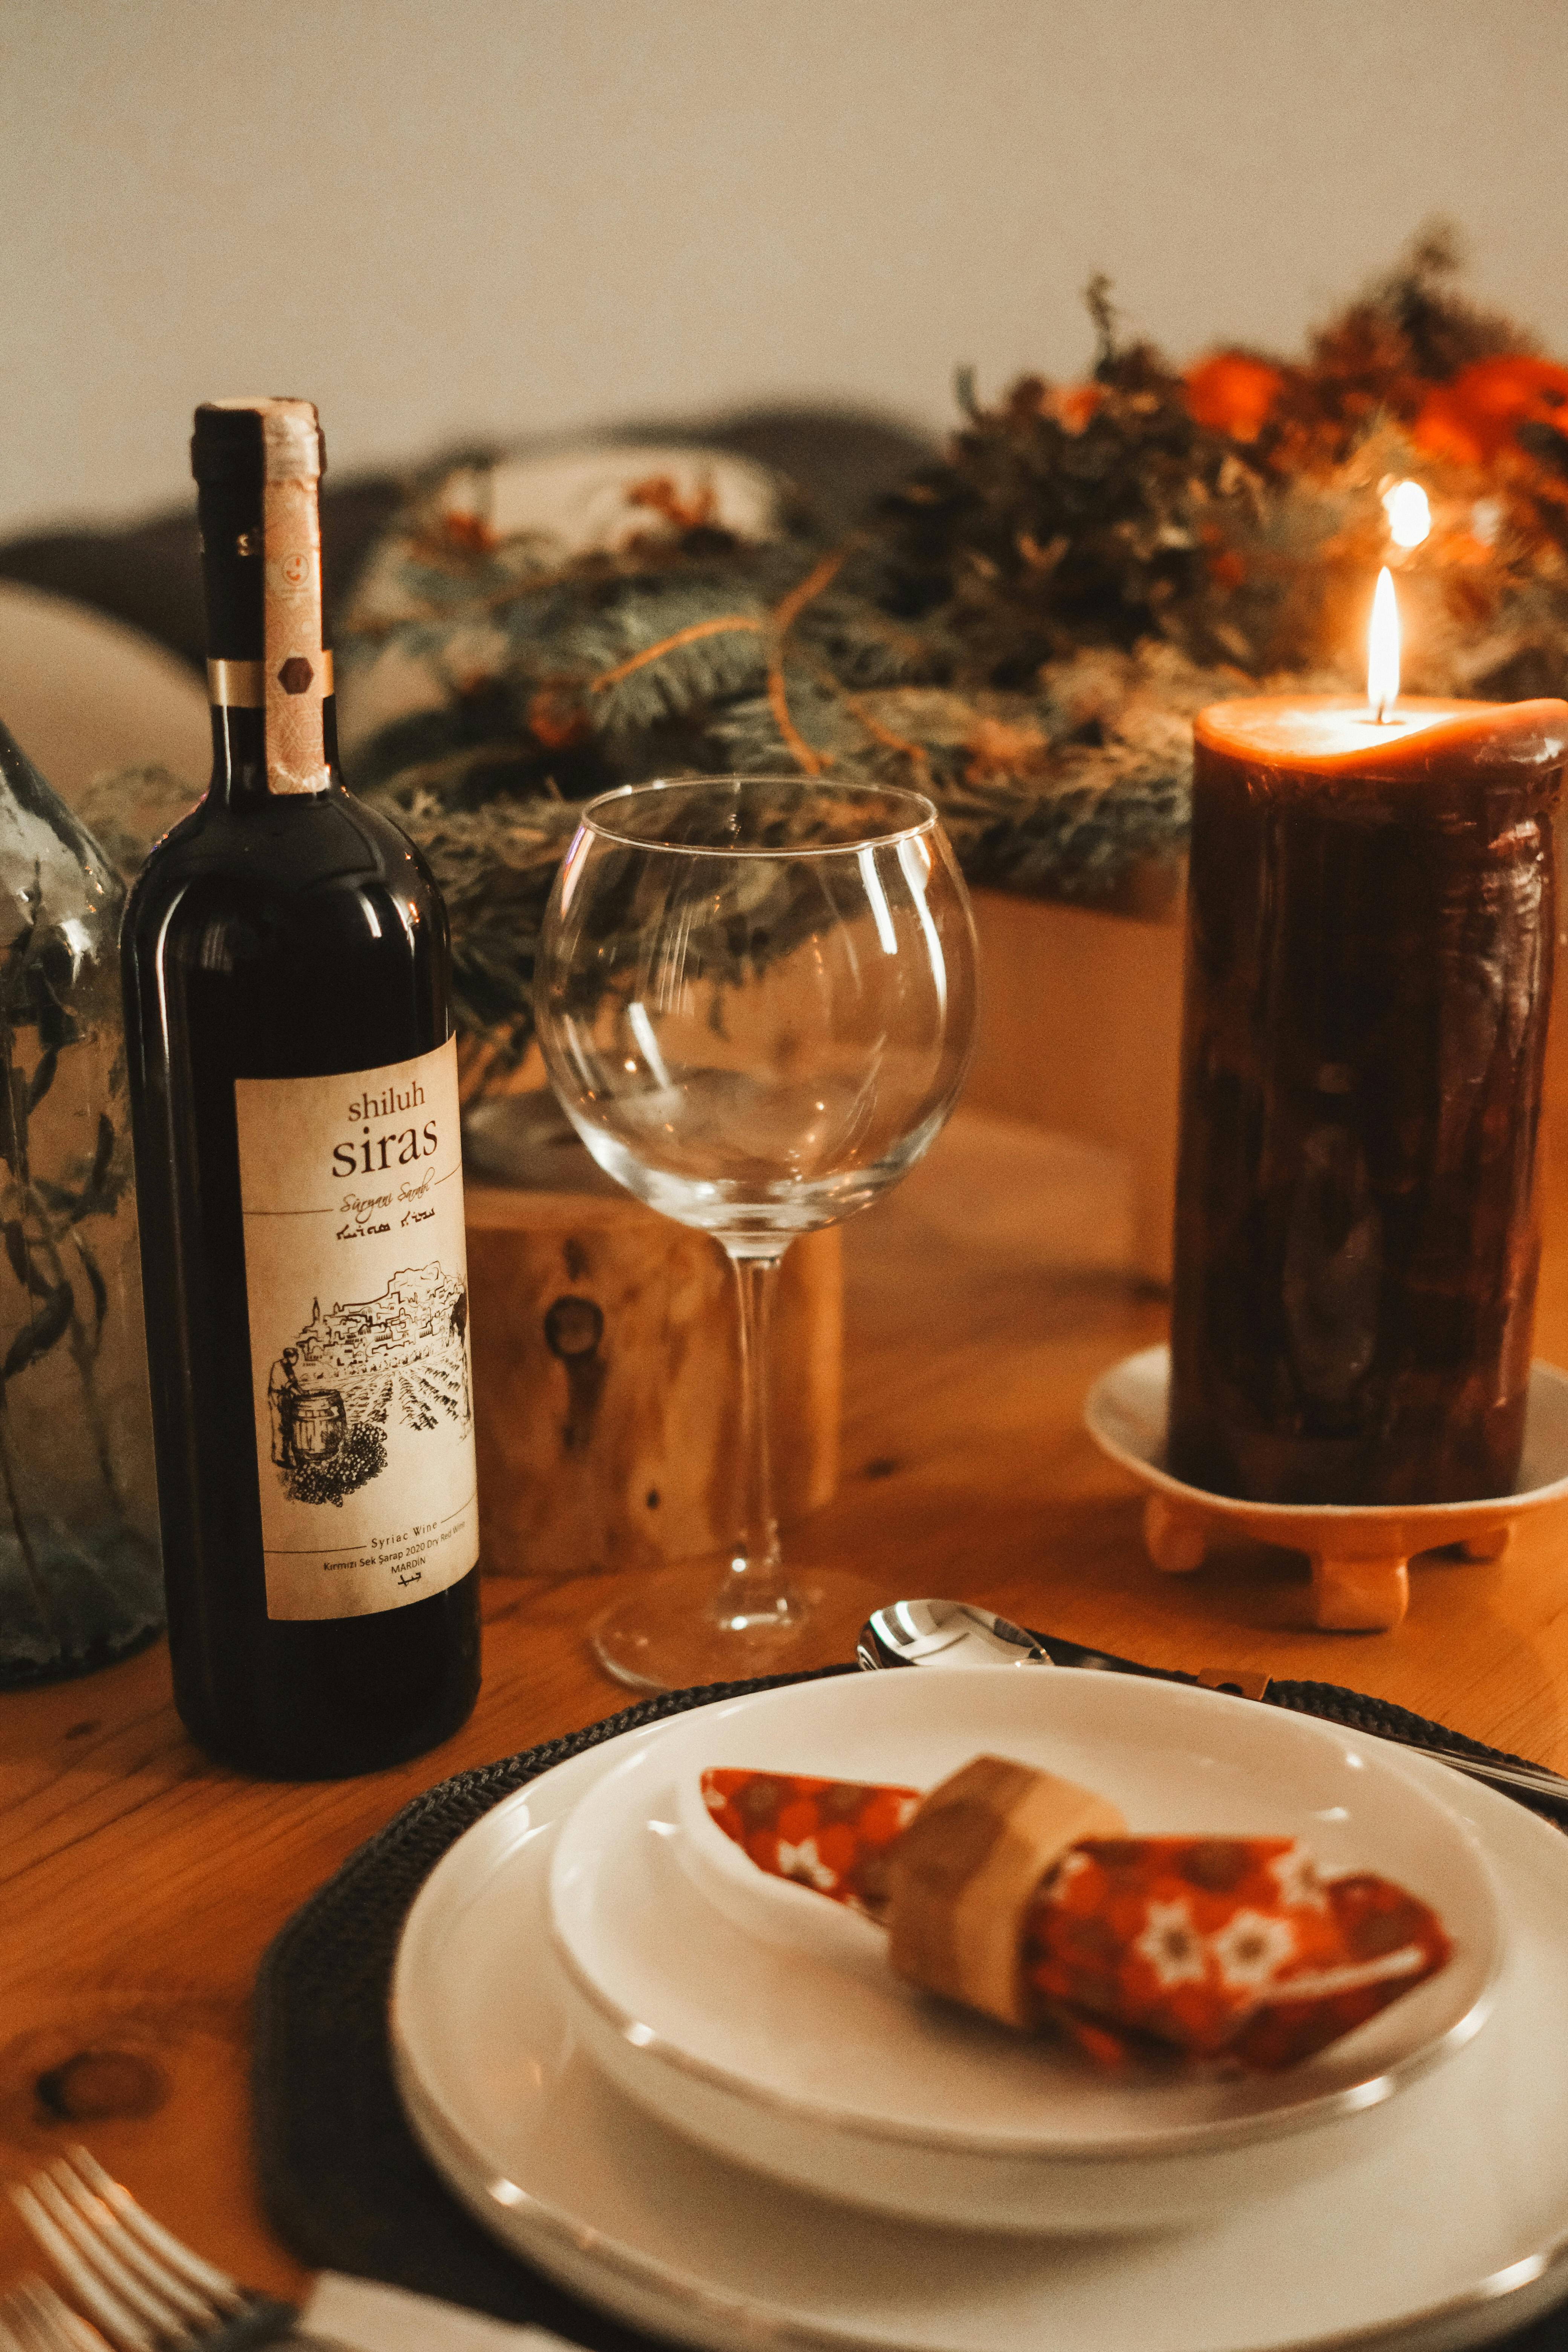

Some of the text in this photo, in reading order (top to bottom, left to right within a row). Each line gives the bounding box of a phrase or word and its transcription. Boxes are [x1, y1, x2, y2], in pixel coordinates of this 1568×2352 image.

[348, 1081, 426, 1122] shiluh
[332, 1120, 438, 1178] siras
[360, 1557, 376, 1567] Sek
[378, 1551, 403, 1565] Şarap
[406, 1542, 425, 1556] 2020
[427, 1538, 439, 1548] Dry
[440, 1528, 452, 1542] Red
[371, 1522, 438, 1550] Syriac Wine
